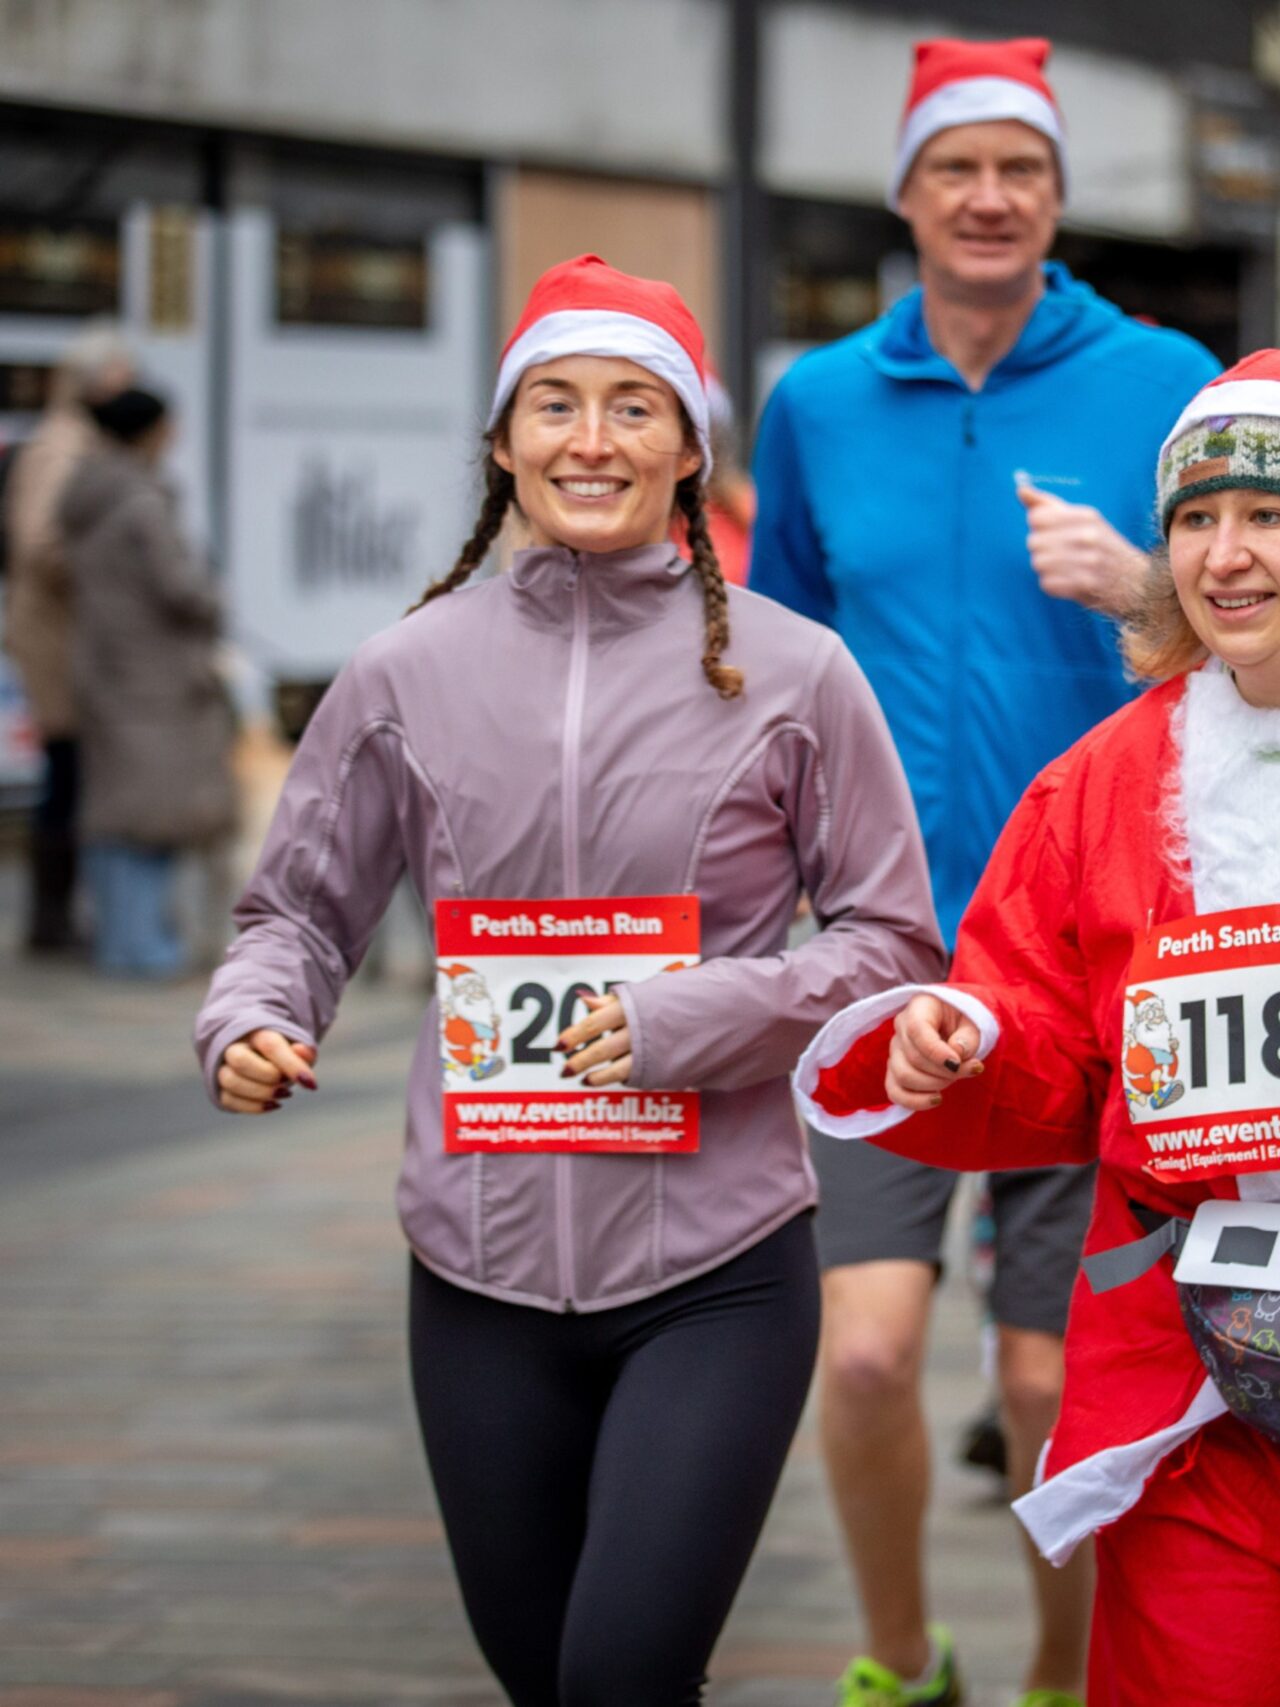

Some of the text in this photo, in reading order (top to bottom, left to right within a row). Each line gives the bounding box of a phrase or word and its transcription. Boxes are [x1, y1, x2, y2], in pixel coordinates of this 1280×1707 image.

[470, 912, 663, 936] Perth Santa Run
[1157, 930, 1214, 959] Perth
[509, 981, 627, 1064] 20
[456, 1096, 684, 1123] www.eventfull.biz
[1154, 1156, 1186, 1171] Timing
[1192, 1148, 1258, 1168] Equipment
